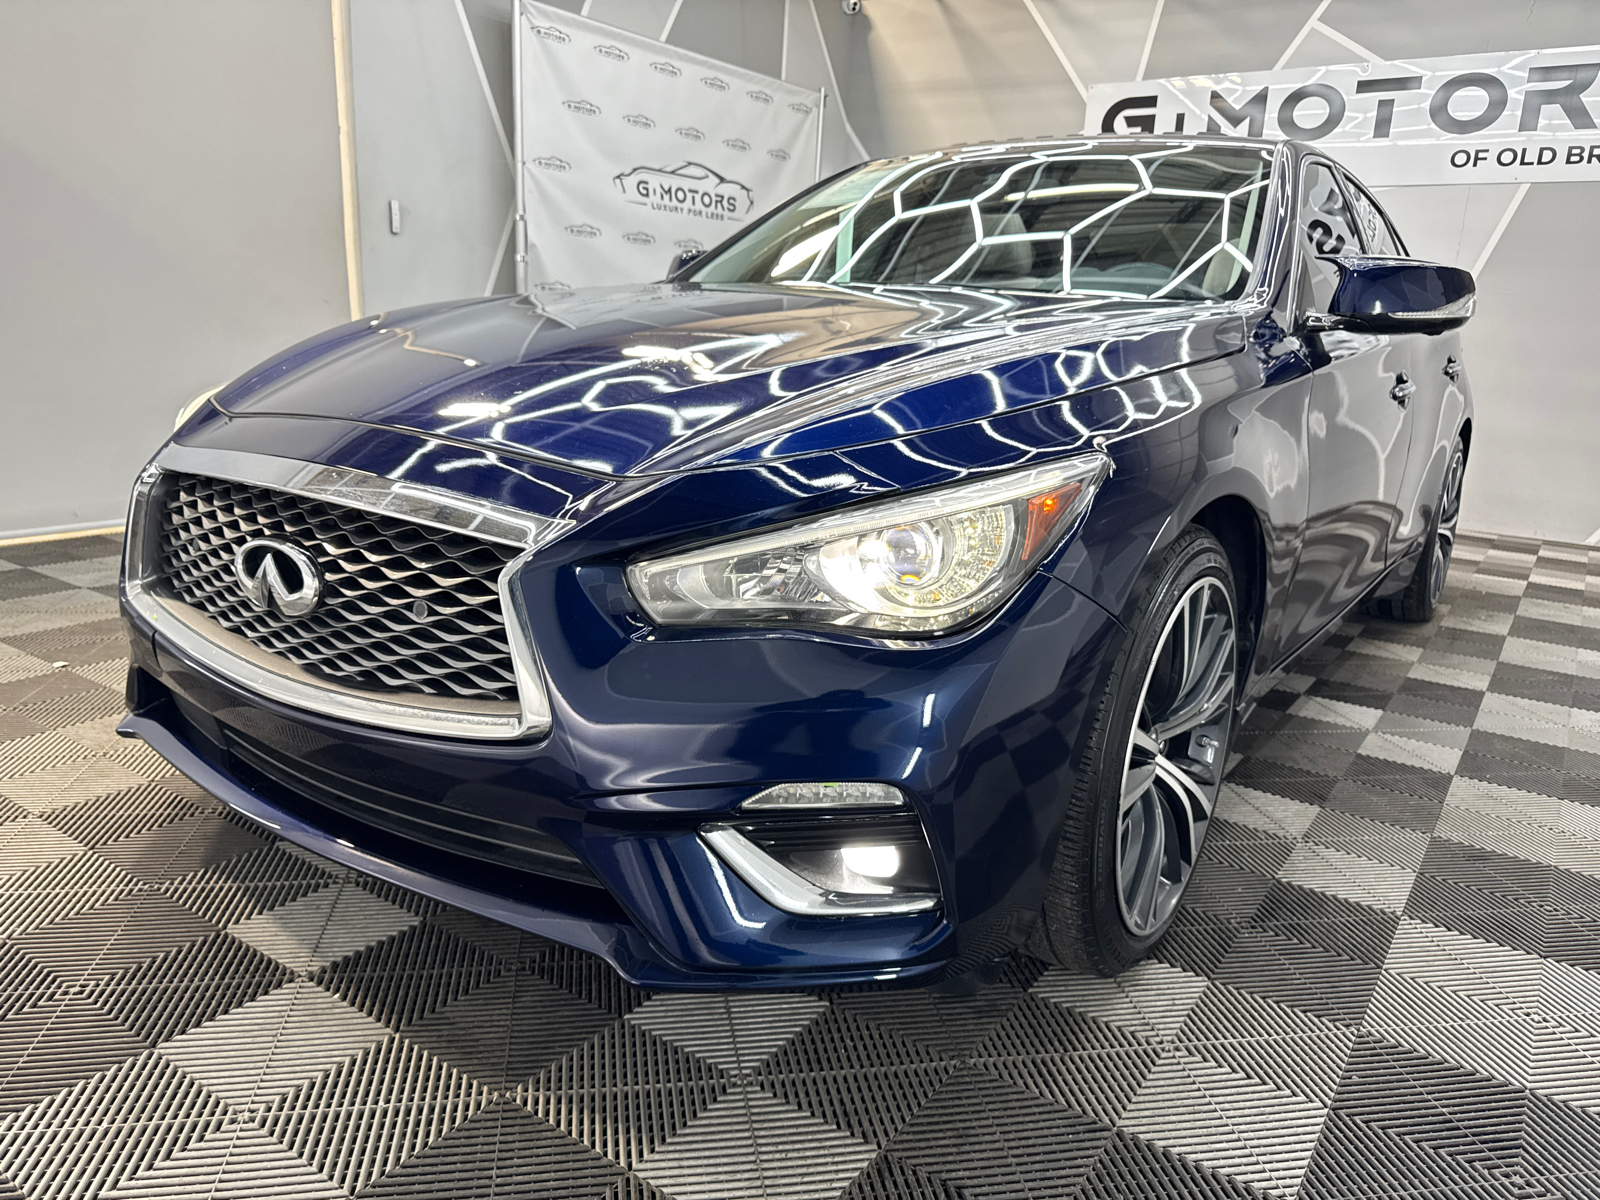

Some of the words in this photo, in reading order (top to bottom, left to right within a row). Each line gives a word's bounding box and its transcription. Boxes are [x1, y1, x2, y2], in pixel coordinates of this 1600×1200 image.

[1450, 149, 1489, 168] OF
[1496, 147, 1557, 167] OLD
[1565, 145, 1600, 165] BR
[651, 202, 684, 214] LUXURY
[687, 207, 703, 218] FOR
[705, 211, 725, 221] LESS
